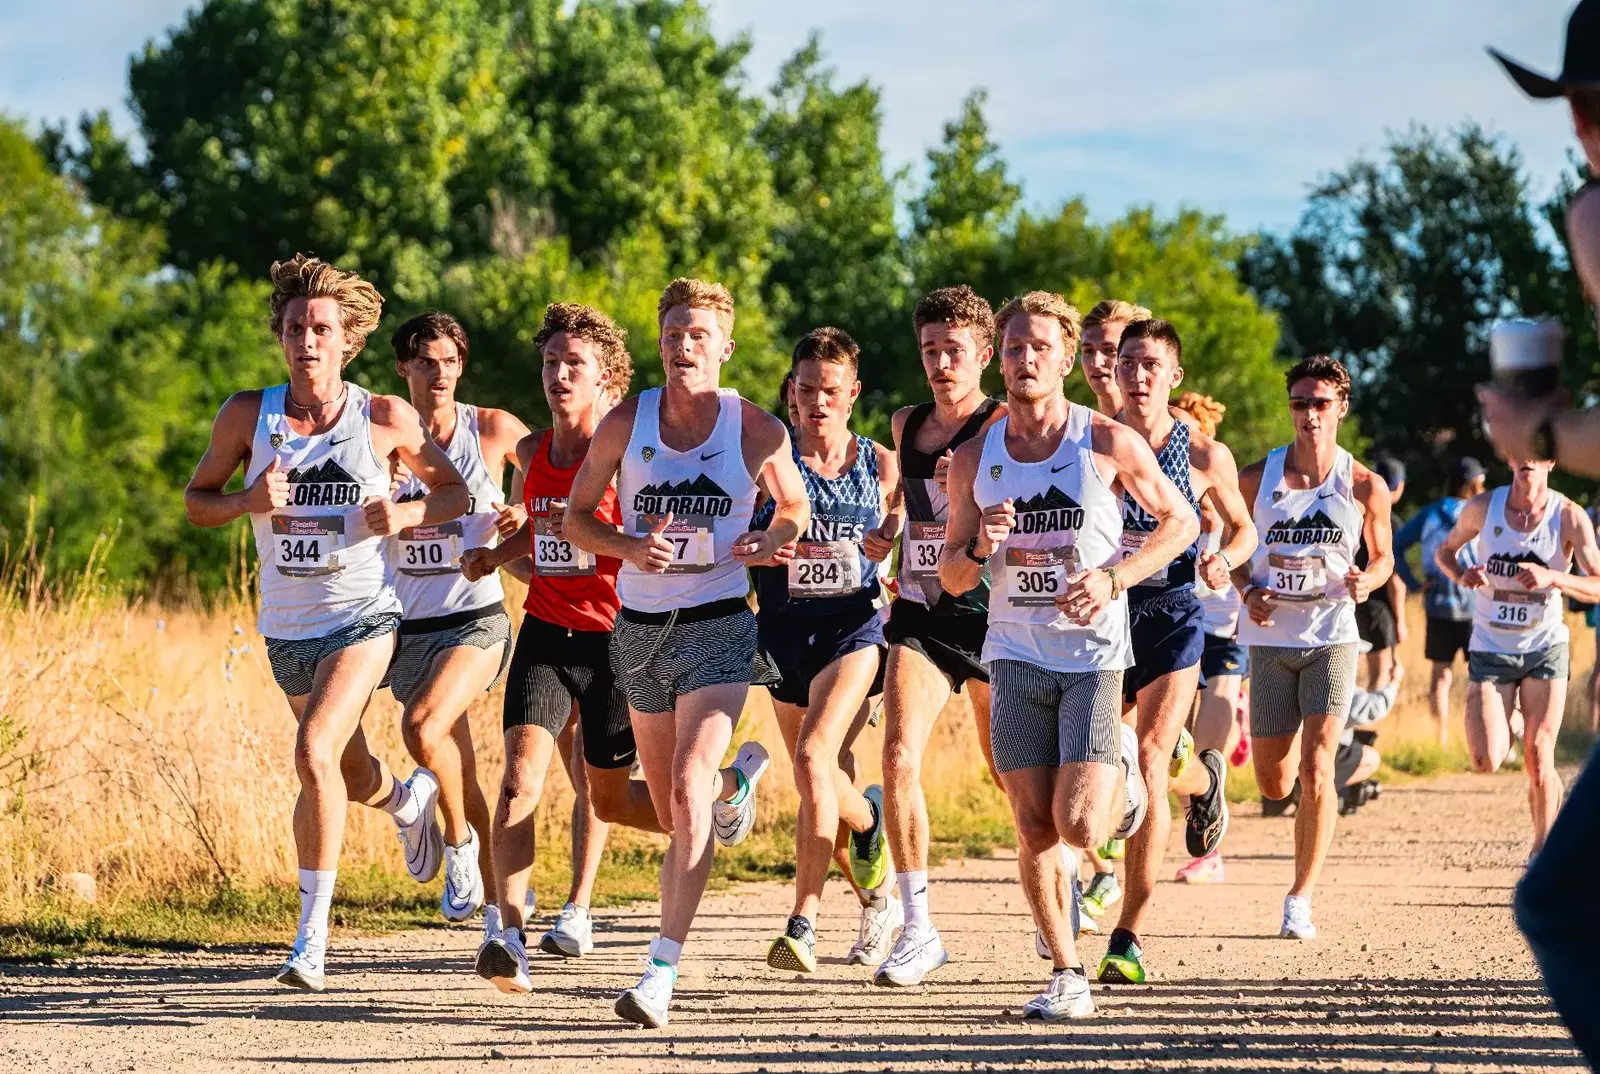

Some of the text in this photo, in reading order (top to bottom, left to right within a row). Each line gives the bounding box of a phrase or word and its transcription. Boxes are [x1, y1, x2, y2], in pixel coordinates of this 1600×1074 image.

[286, 484, 361, 506] LORADO
[633, 495, 733, 517] COLORADO
[802, 519, 865, 542] INES
[1009, 508, 1085, 534] LORADO
[1265, 530, 1342, 545] COLORADO
[281, 540, 320, 562] 344
[406, 544, 442, 565] 310
[539, 540, 573, 562] 333
[798, 563, 838, 585] 284
[1016, 571, 1058, 593] 305
[1276, 572, 1307, 591] 317
[1497, 605, 1528, 622] 316
